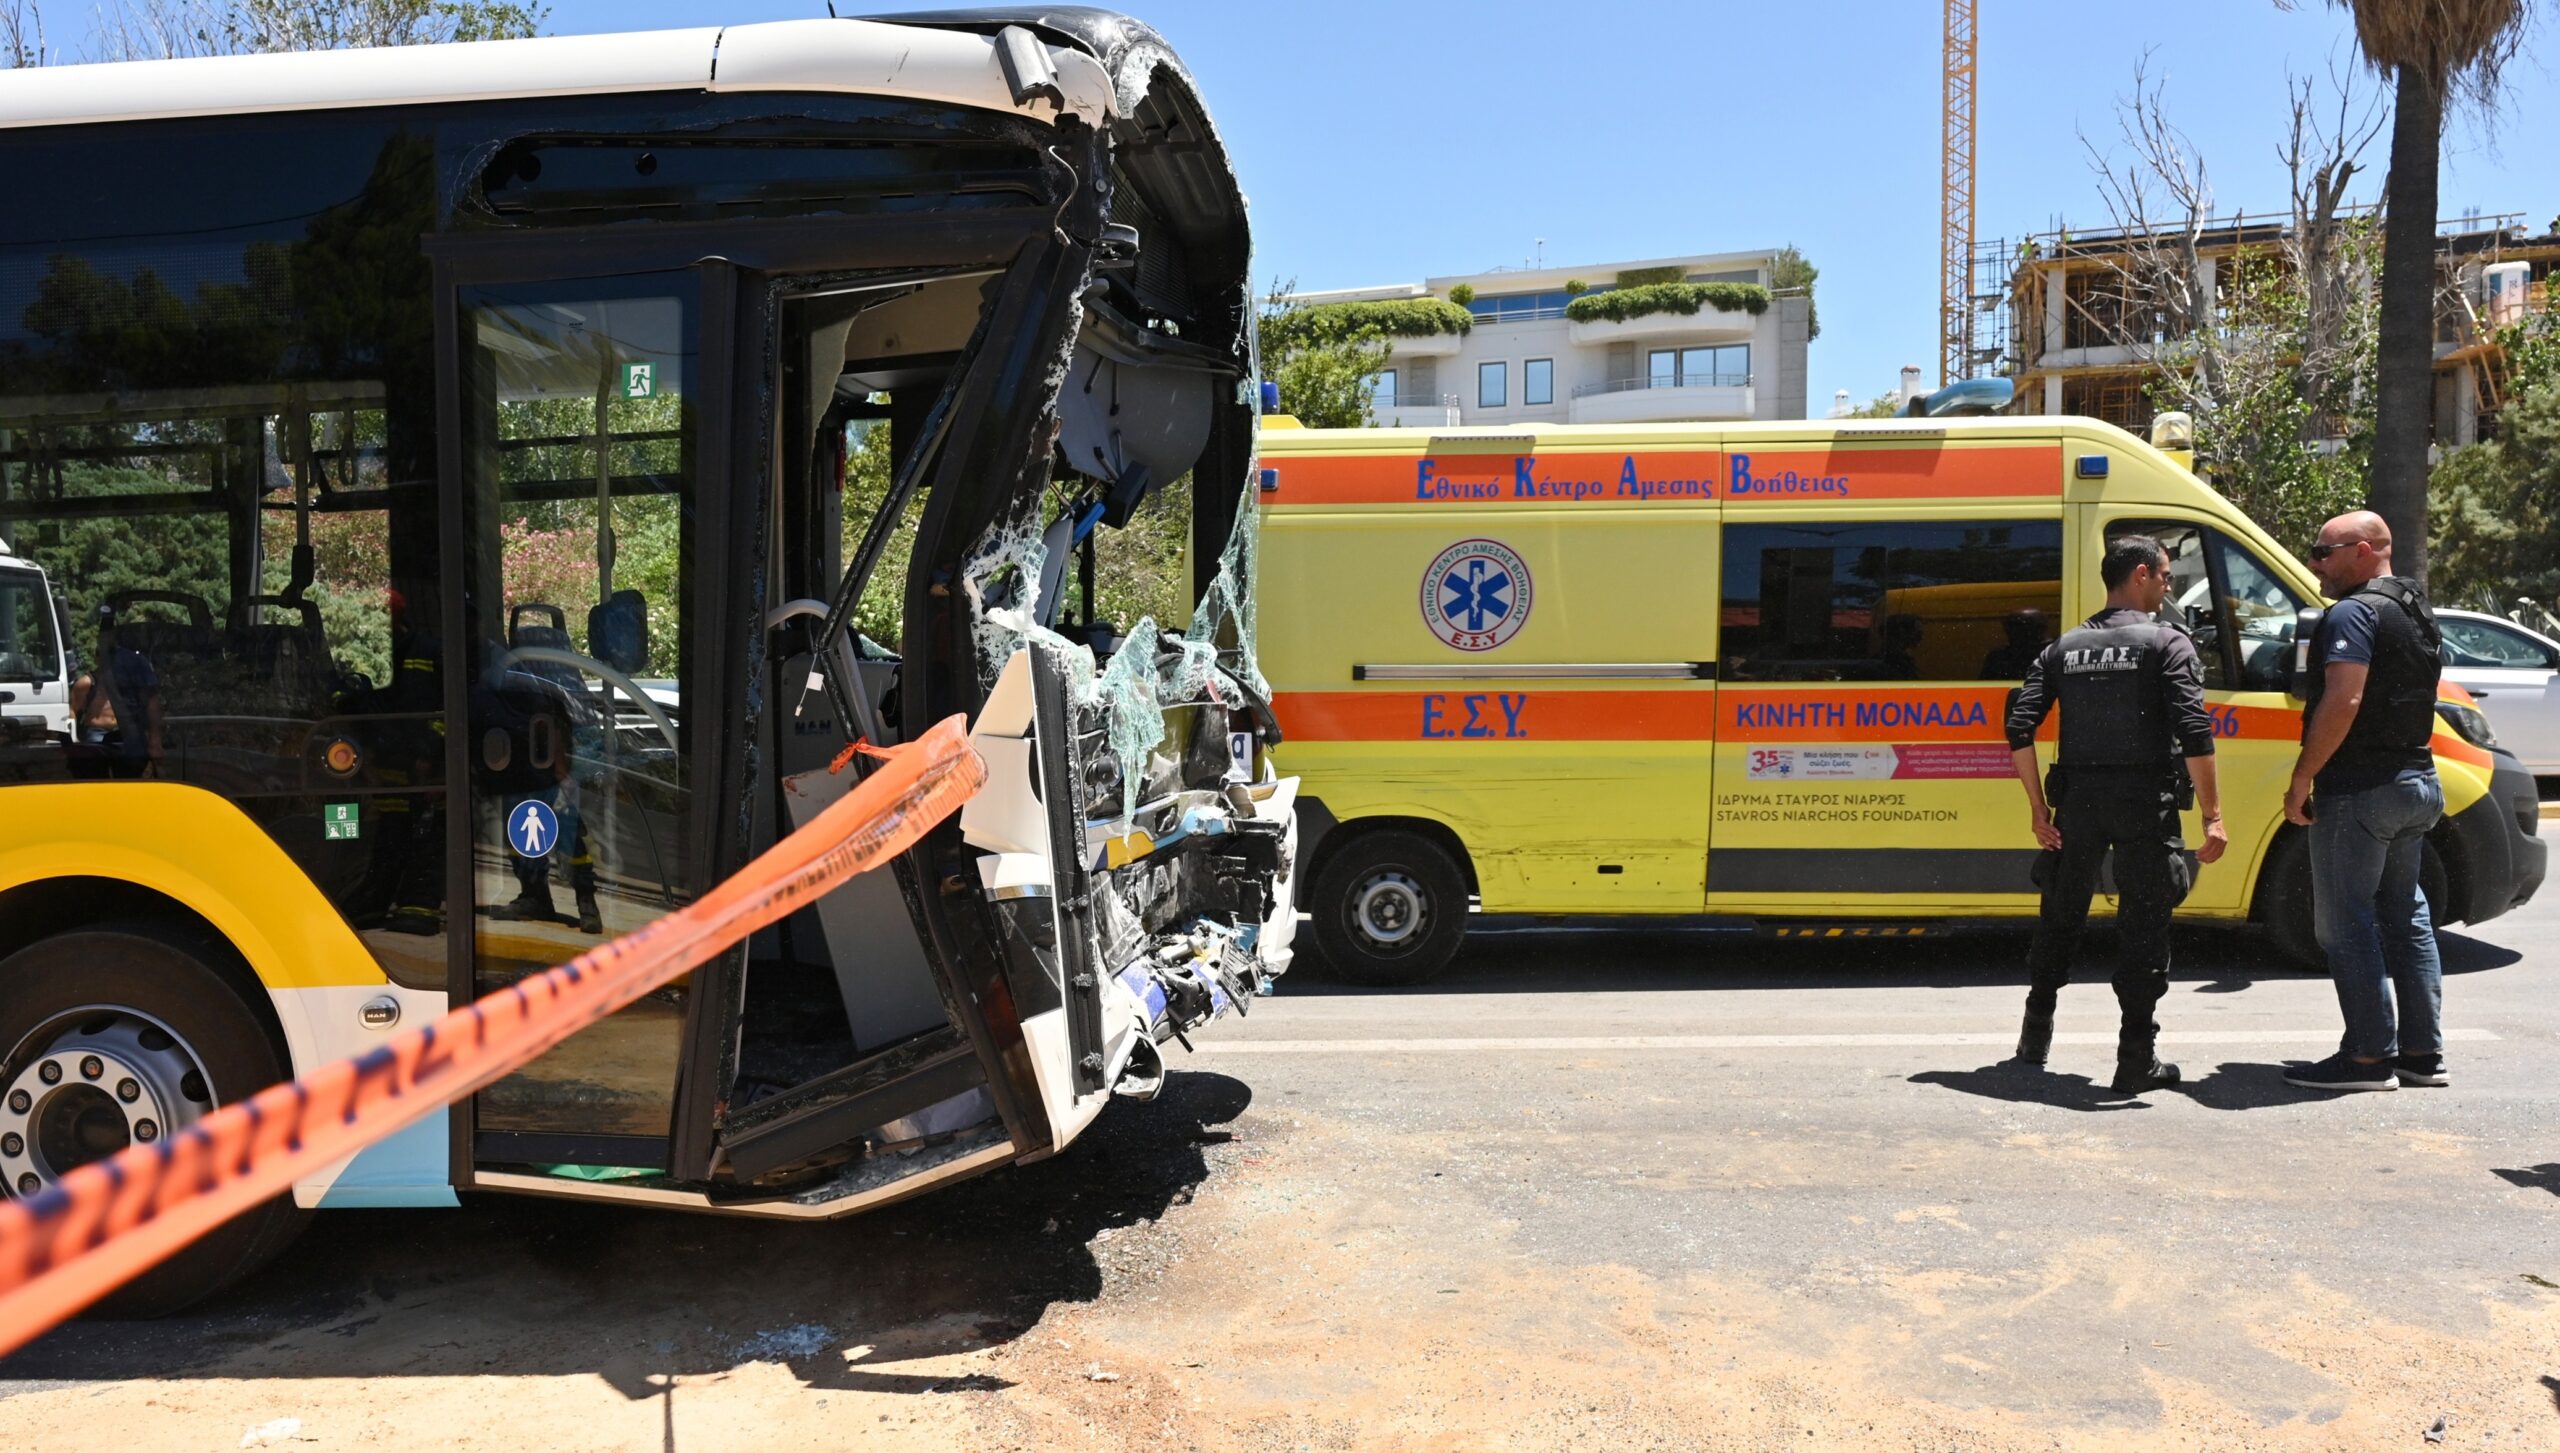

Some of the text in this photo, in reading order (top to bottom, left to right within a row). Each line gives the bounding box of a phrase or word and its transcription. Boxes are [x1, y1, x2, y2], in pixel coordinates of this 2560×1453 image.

[1416, 453, 1849, 501] Εθνικό Κέντρο Αμεσης Βοήθειας
[1432, 545, 1470, 577] ΚΕΝΤΡΟ
[1472, 543, 1514, 565] ΑΜΕΣΗΣ
[1451, 632, 1497, 648] Ε.Σ.Υ
[1421, 694, 1528, 738] Ε.Σ.Υ.
[1737, 702, 1988, 727] ΚΙΝΗΤΗ ΜΟΝΑΔΑ
[1717, 793, 1906, 806] ΙΔΡΥΜΑ ΣΤΑΥΡΟΣ ΝΙΑΡΧΟΣ
[1716, 810, 1958, 822] STAVROS NIARCHOS FOUNDATION
